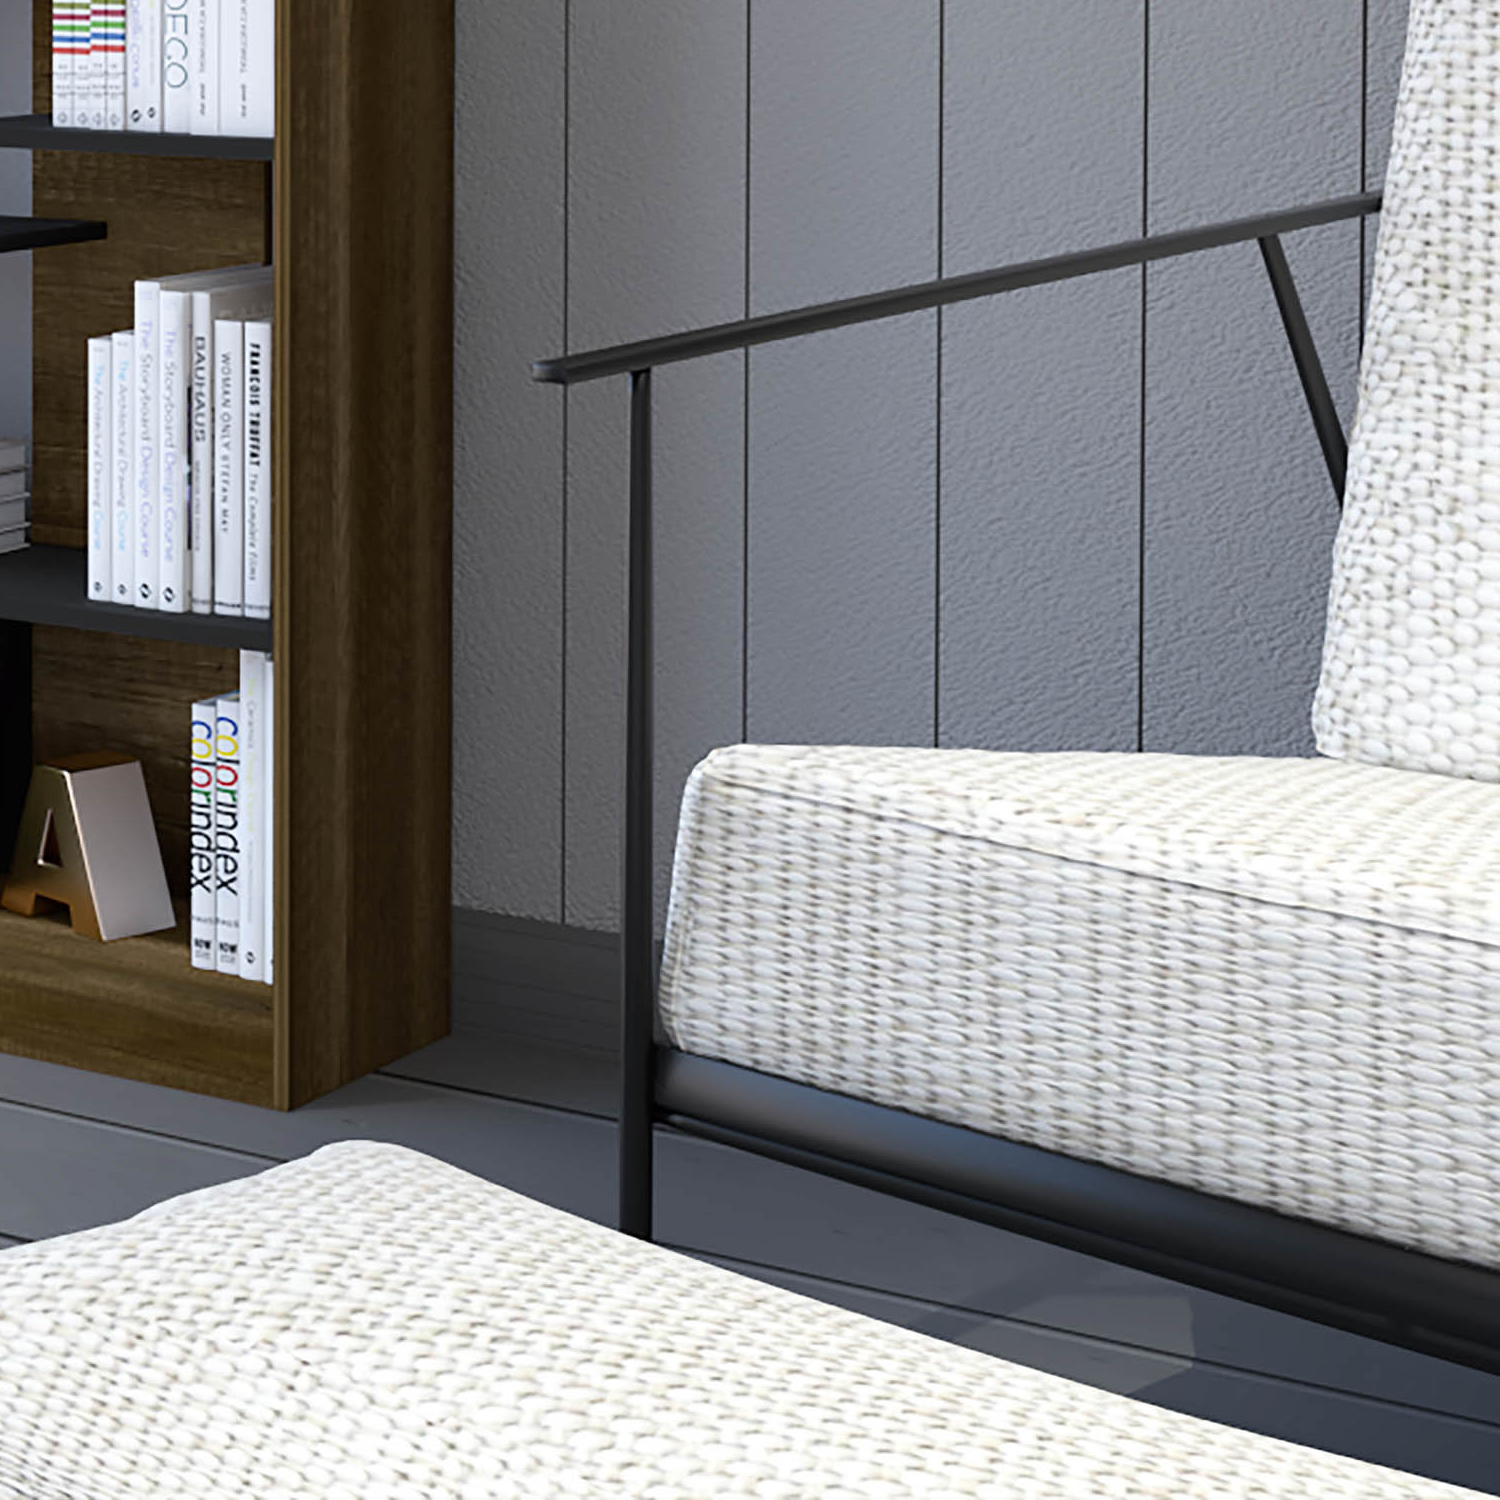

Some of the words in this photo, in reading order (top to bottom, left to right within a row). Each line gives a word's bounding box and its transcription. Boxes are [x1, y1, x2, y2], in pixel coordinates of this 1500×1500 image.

[194, 336, 206, 442] BAUHAUS
[221, 353, 231, 408] WOMAN
[221, 412, 231, 450] ONLY
[191, 720, 216, 893] colorindex
[216, 716, 240, 896] colorindex
